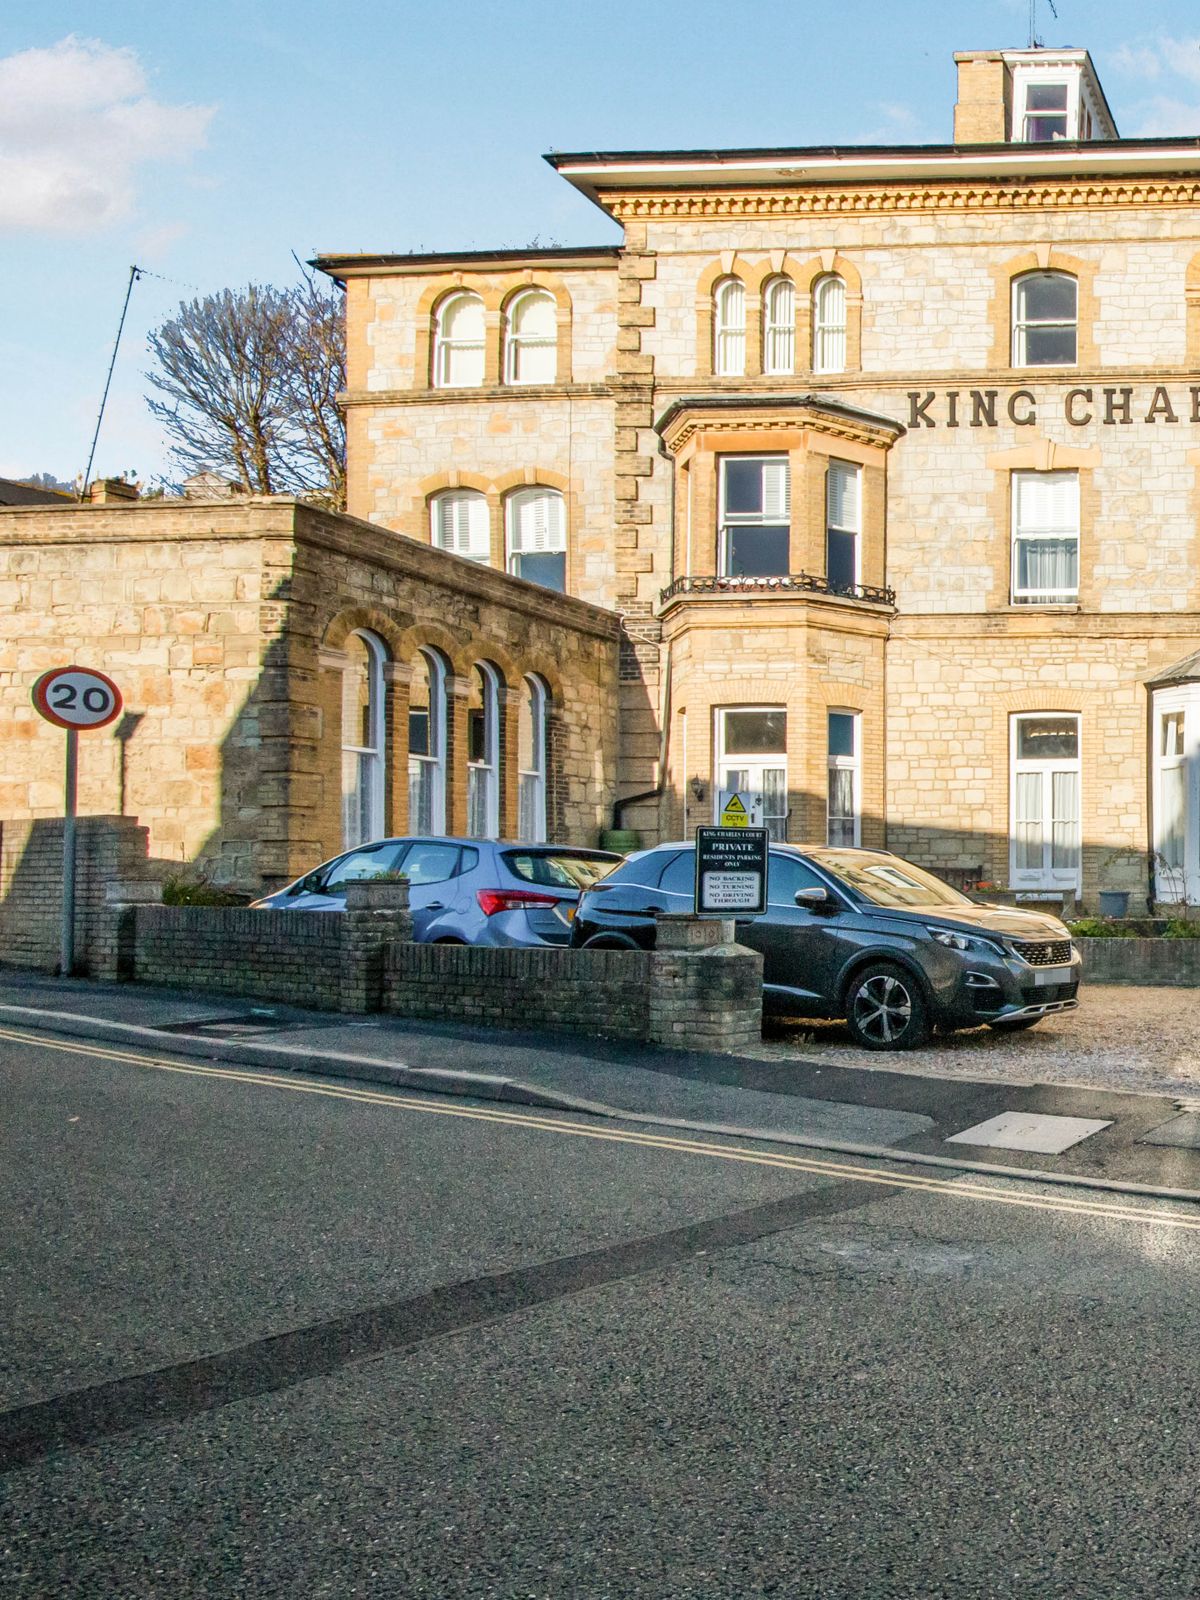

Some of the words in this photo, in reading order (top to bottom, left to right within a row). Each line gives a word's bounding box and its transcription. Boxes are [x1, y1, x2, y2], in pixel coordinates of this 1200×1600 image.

[906, 389, 1036, 428] KING
[52, 683, 110, 713] 20
[712, 843, 754, 851] PRIVATE
